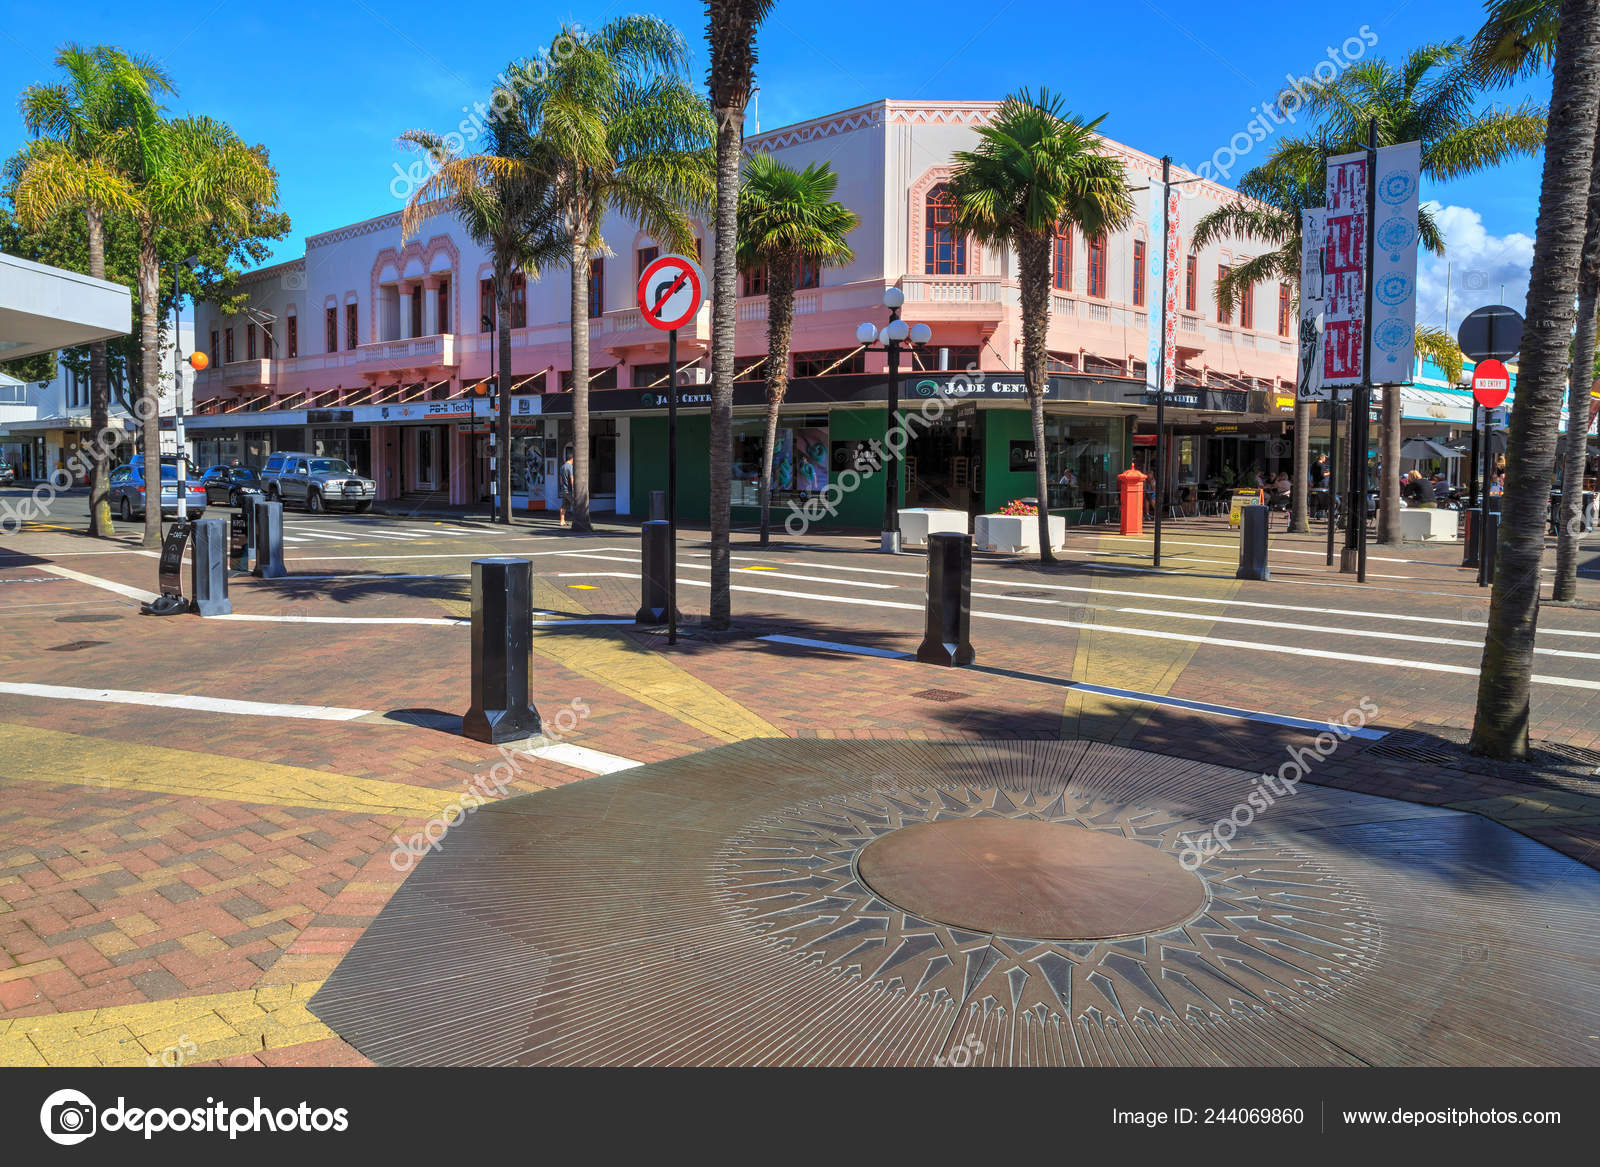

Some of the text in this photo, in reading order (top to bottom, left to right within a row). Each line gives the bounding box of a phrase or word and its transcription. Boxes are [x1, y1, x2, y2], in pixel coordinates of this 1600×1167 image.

[945, 382, 1050, 395] JADE CENTE
[1479, 380, 1502, 388] NO ENTRY
[682, 394, 712, 403] CENTR
